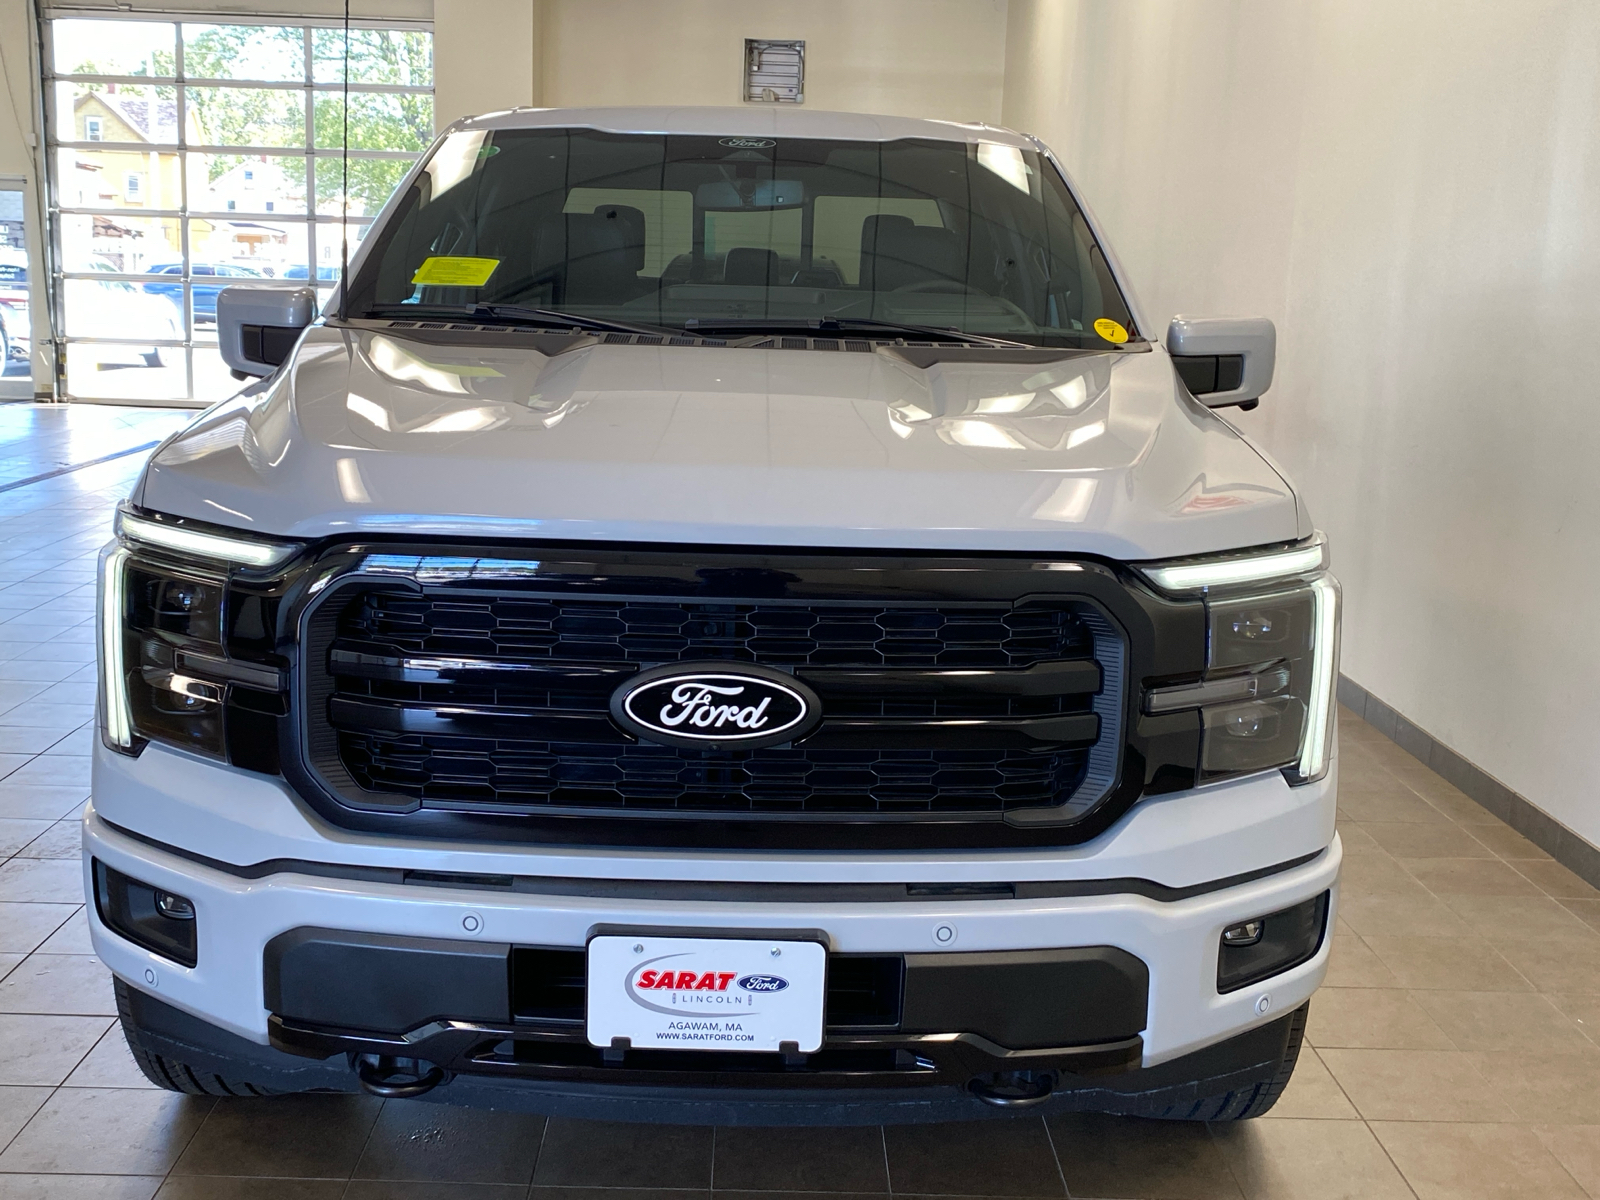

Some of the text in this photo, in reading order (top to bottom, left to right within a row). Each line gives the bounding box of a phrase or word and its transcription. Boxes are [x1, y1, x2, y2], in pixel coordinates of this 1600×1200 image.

[728, 138, 767, 147] Ford
[659, 682, 772, 729] Ford
[635, 969, 780, 992] SARAT Ford
[682, 995, 742, 1004] LINCOLN
[668, 1021, 743, 1032] AGAWAM, MA
[656, 1032, 755, 1042] WWW.SARATFORD.COM
